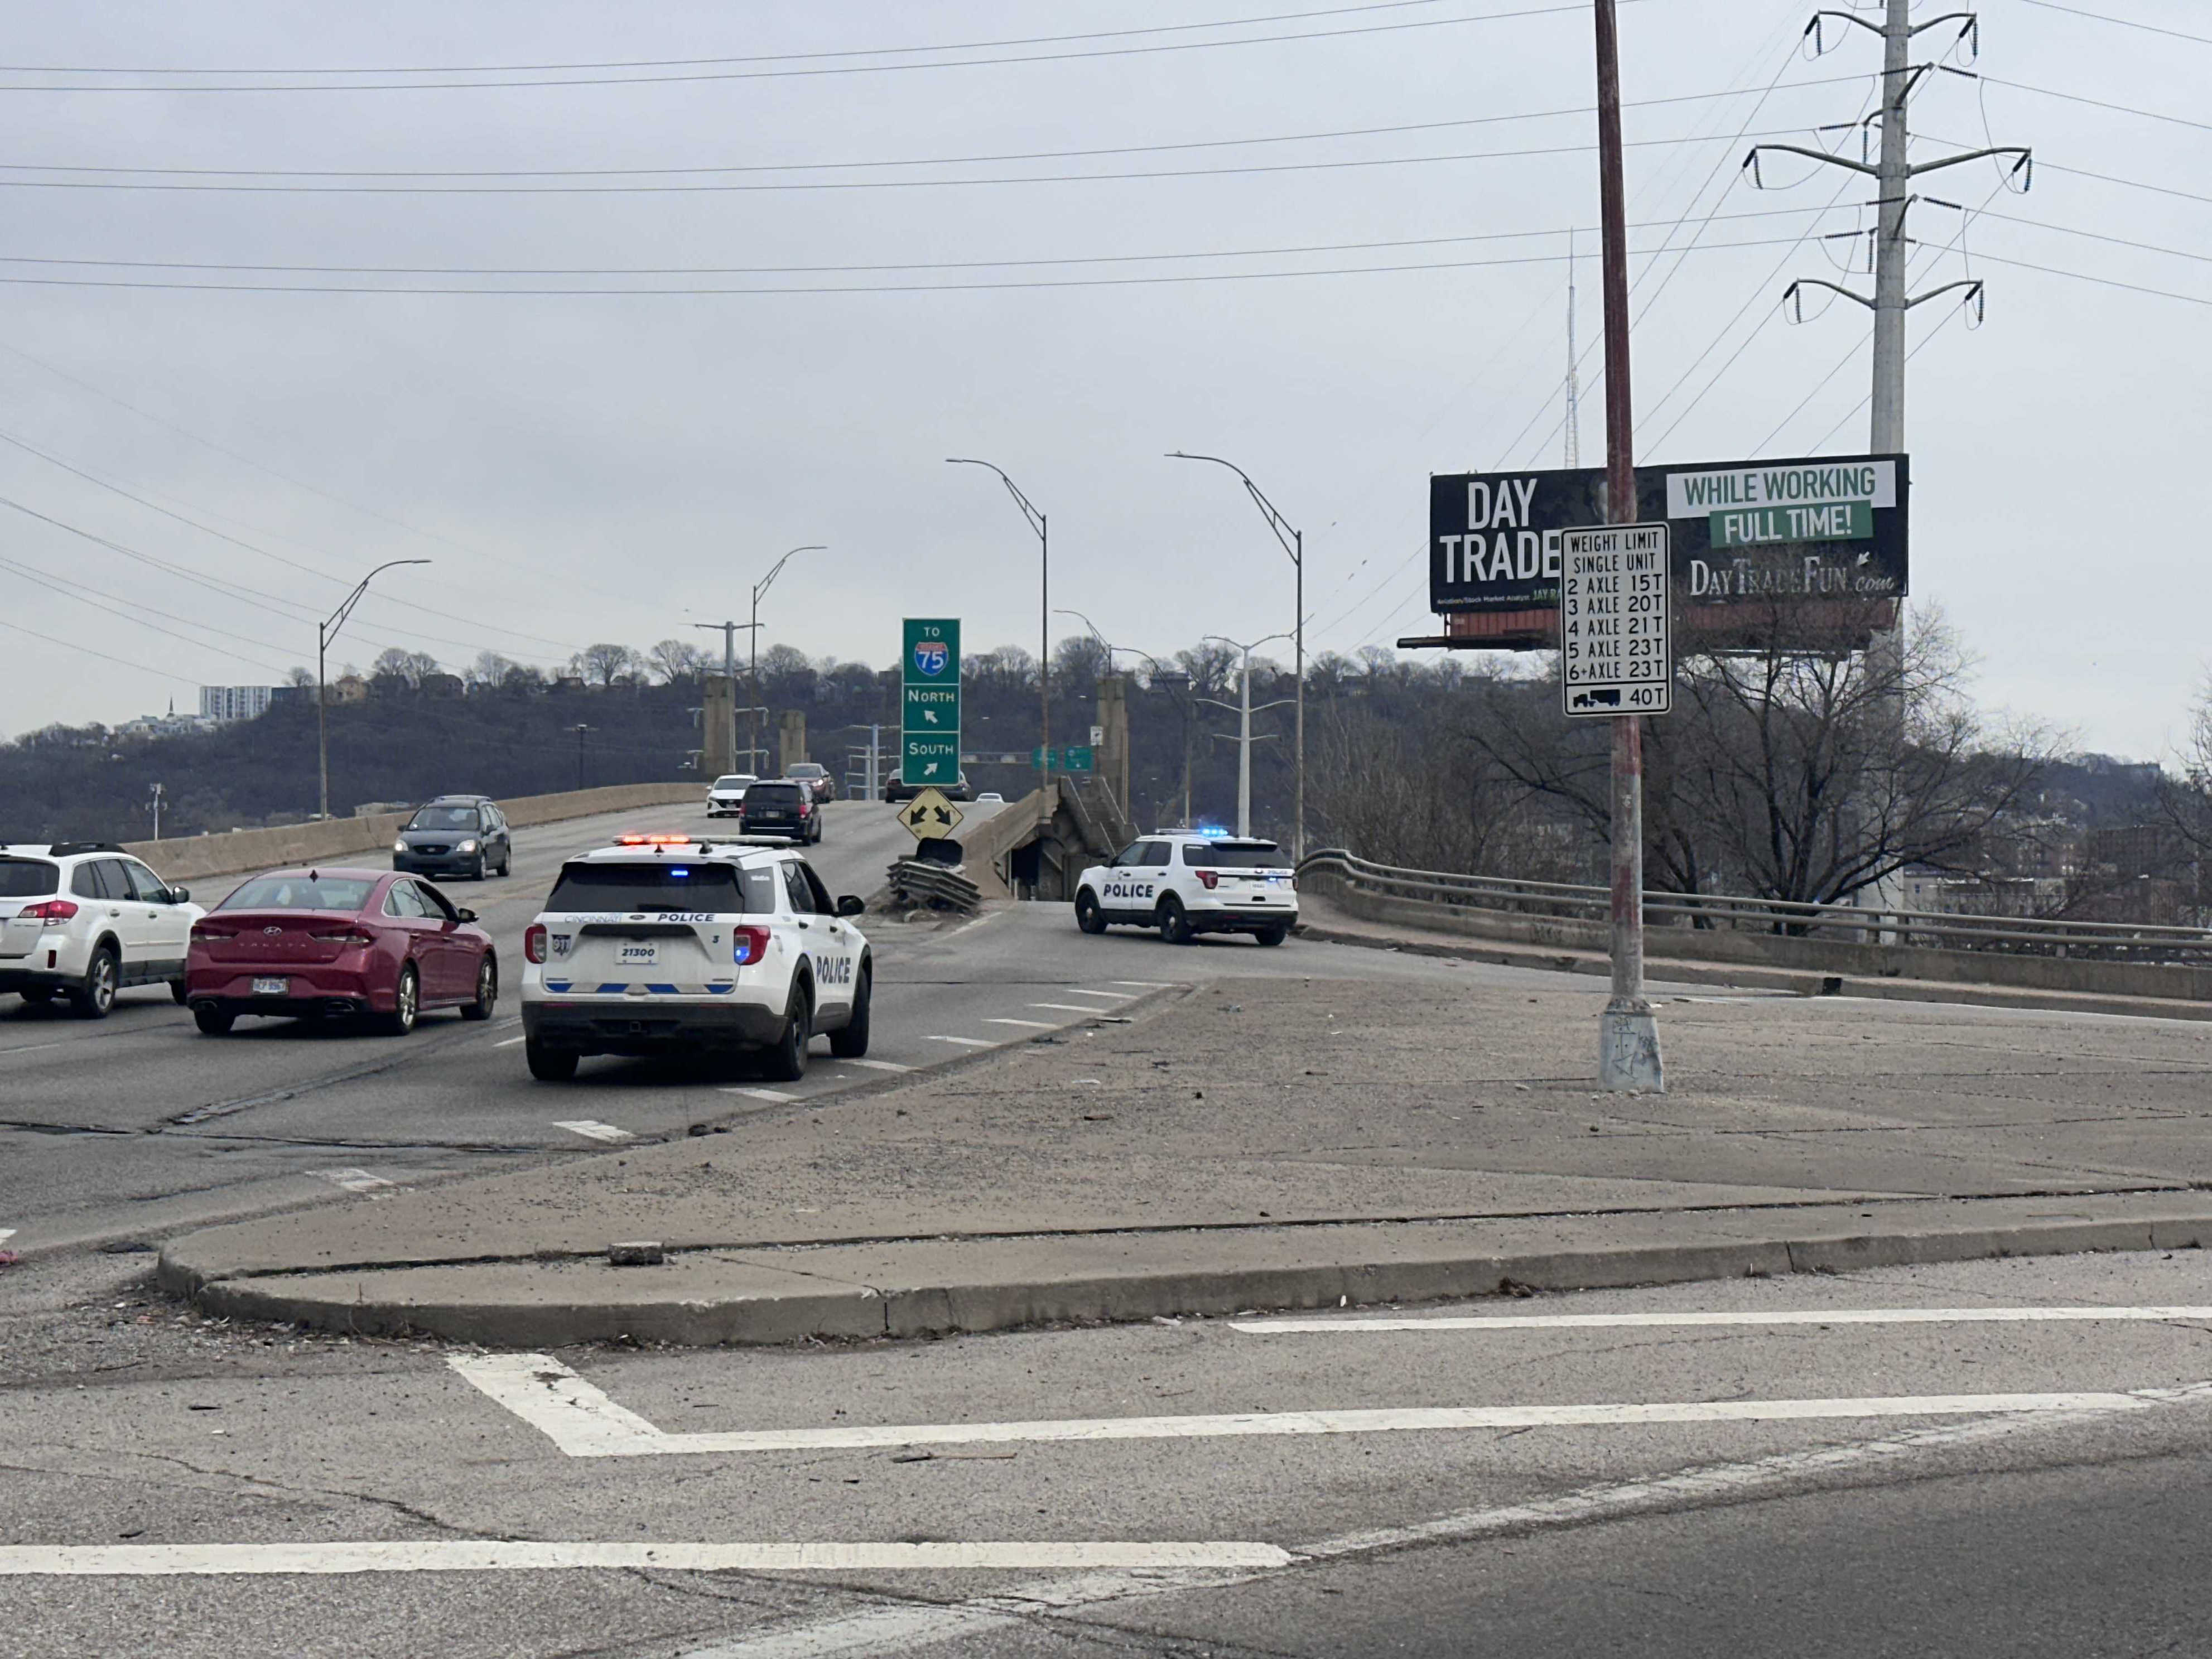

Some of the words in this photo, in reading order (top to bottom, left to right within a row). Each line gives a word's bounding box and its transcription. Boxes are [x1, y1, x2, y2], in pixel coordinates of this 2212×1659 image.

[1684, 472, 1758, 505] WHILE
[1763, 466, 1876, 500] WORKING
[1468, 478, 1538, 530] DAY
[1724, 511, 1782, 543] FULL
[1786, 504, 1853, 538] TIME!
[1570, 533, 1618, 553] WEIGHT
[1626, 532, 1658, 550] LIMIT
[1439, 530, 1561, 583] TRADE
[1573, 554, 1620, 574] SINGLE
[1627, 552, 1655, 571] UNIT
[1567, 578, 1578, 595] 2
[1587, 576, 1620, 595] AXLE
[1631, 573, 1662, 592] 15T
[1568, 599, 1578, 616] 3
[1588, 596, 1620, 615] AXLE
[1628, 594, 1662, 613] 20T
[923, 626, 940, 637] TO
[1568, 620, 1579, 637] 4
[1588, 618, 1621, 636] AXLE
[1628, 616, 1663, 634] 21T
[1569, 642, 1579, 659] 5
[1588, 640, 1621, 658] AXLE
[1629, 638, 1663, 656] 23T
[918, 651, 944, 669] 75
[1629, 659, 1664, 678] 23T
[908, 689, 955, 702] NORTH
[1630, 688, 1664, 706] 40T
[909, 742, 953, 755] SOUTH
[1103, 884, 1154, 898] POLICE
[712, 935, 720, 943] 3
[621, 948, 654, 957] 21300
[816, 956, 851, 984] POLICE
